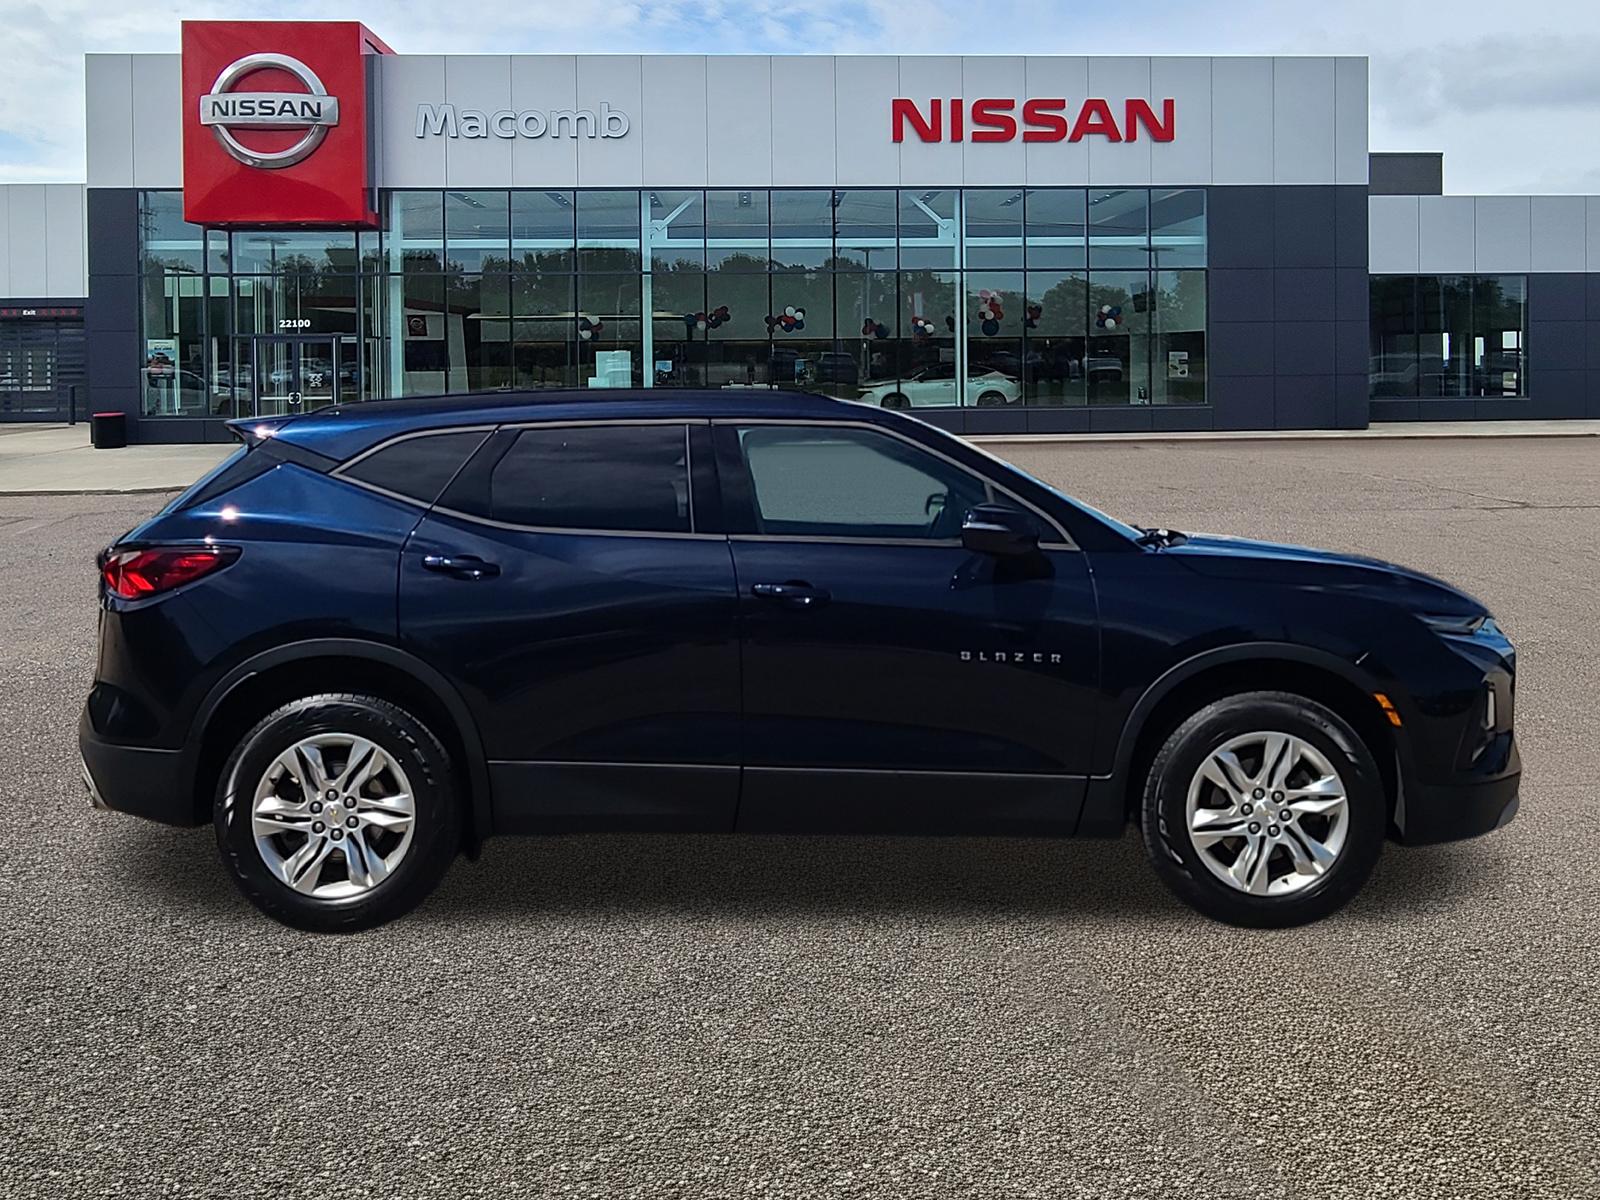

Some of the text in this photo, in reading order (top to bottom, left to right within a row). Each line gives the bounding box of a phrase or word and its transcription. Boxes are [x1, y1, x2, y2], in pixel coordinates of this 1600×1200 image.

[212, 100, 321, 117] NISSAN
[415, 101, 630, 138] Macomb
[891, 98, 1175, 143] NISSAN
[279, 319, 311, 328] 22100
[960, 651, 1062, 663] BLAZER
